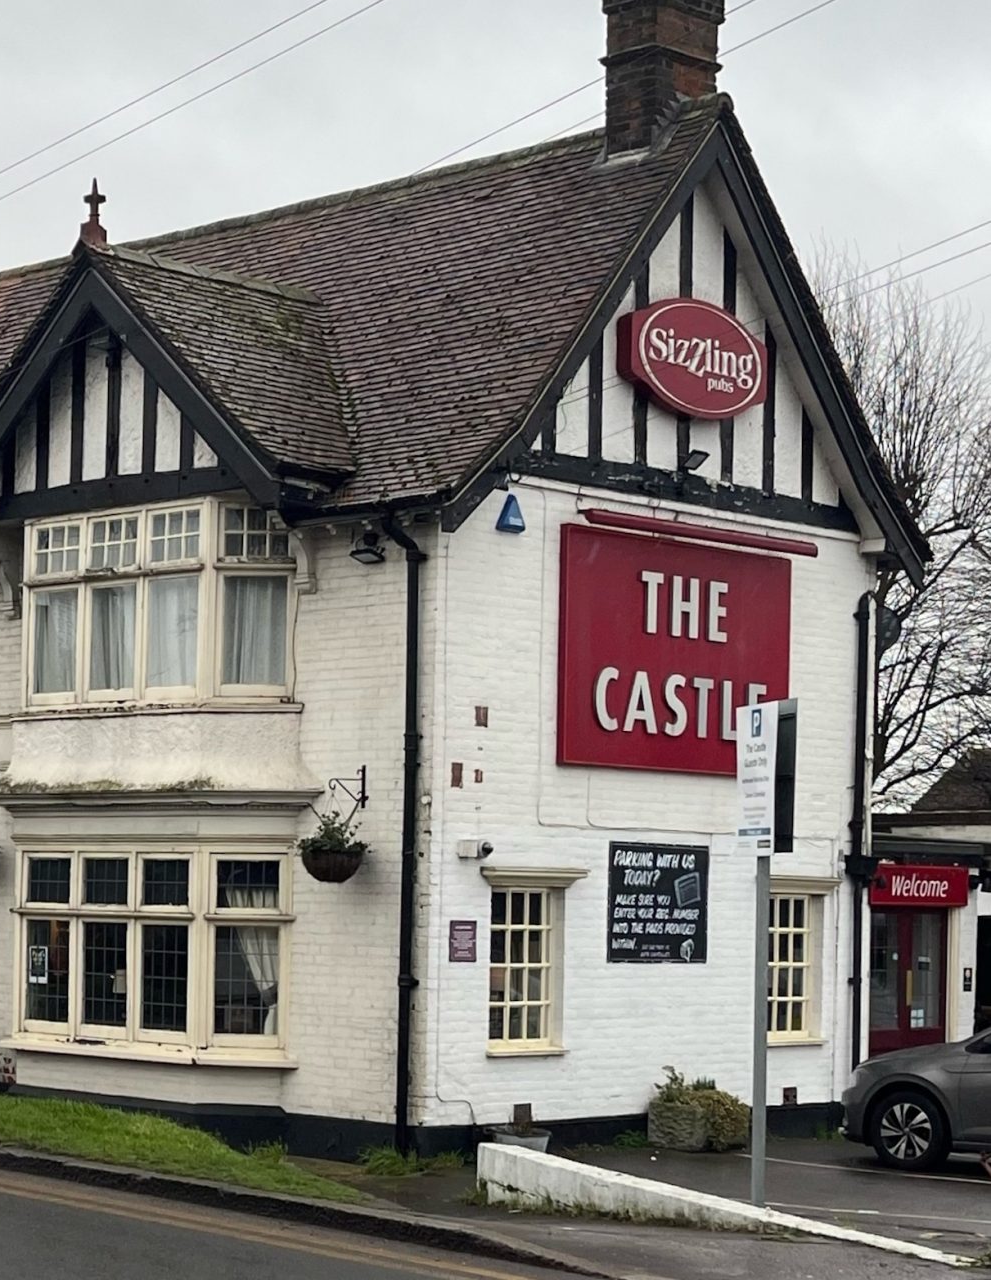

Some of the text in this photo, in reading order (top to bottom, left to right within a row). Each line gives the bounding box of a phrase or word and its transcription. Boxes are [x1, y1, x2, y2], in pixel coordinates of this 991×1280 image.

[707, 377, 734, 394] pubs
[641, 570, 729, 643] THE
[613, 849, 696, 869] PARKING WITH US
[623, 868, 661, 888] TODAY?
[891, 873, 949, 898] Welcome
[614, 893, 671, 906] MAKE SURE YOU
[613, 907, 636, 919] ENTER
[637, 907, 654, 920] YOUR
[671, 908, 700, 920] NUMBER
[612, 922, 696, 935] INTO THE PADS PROVIDED
